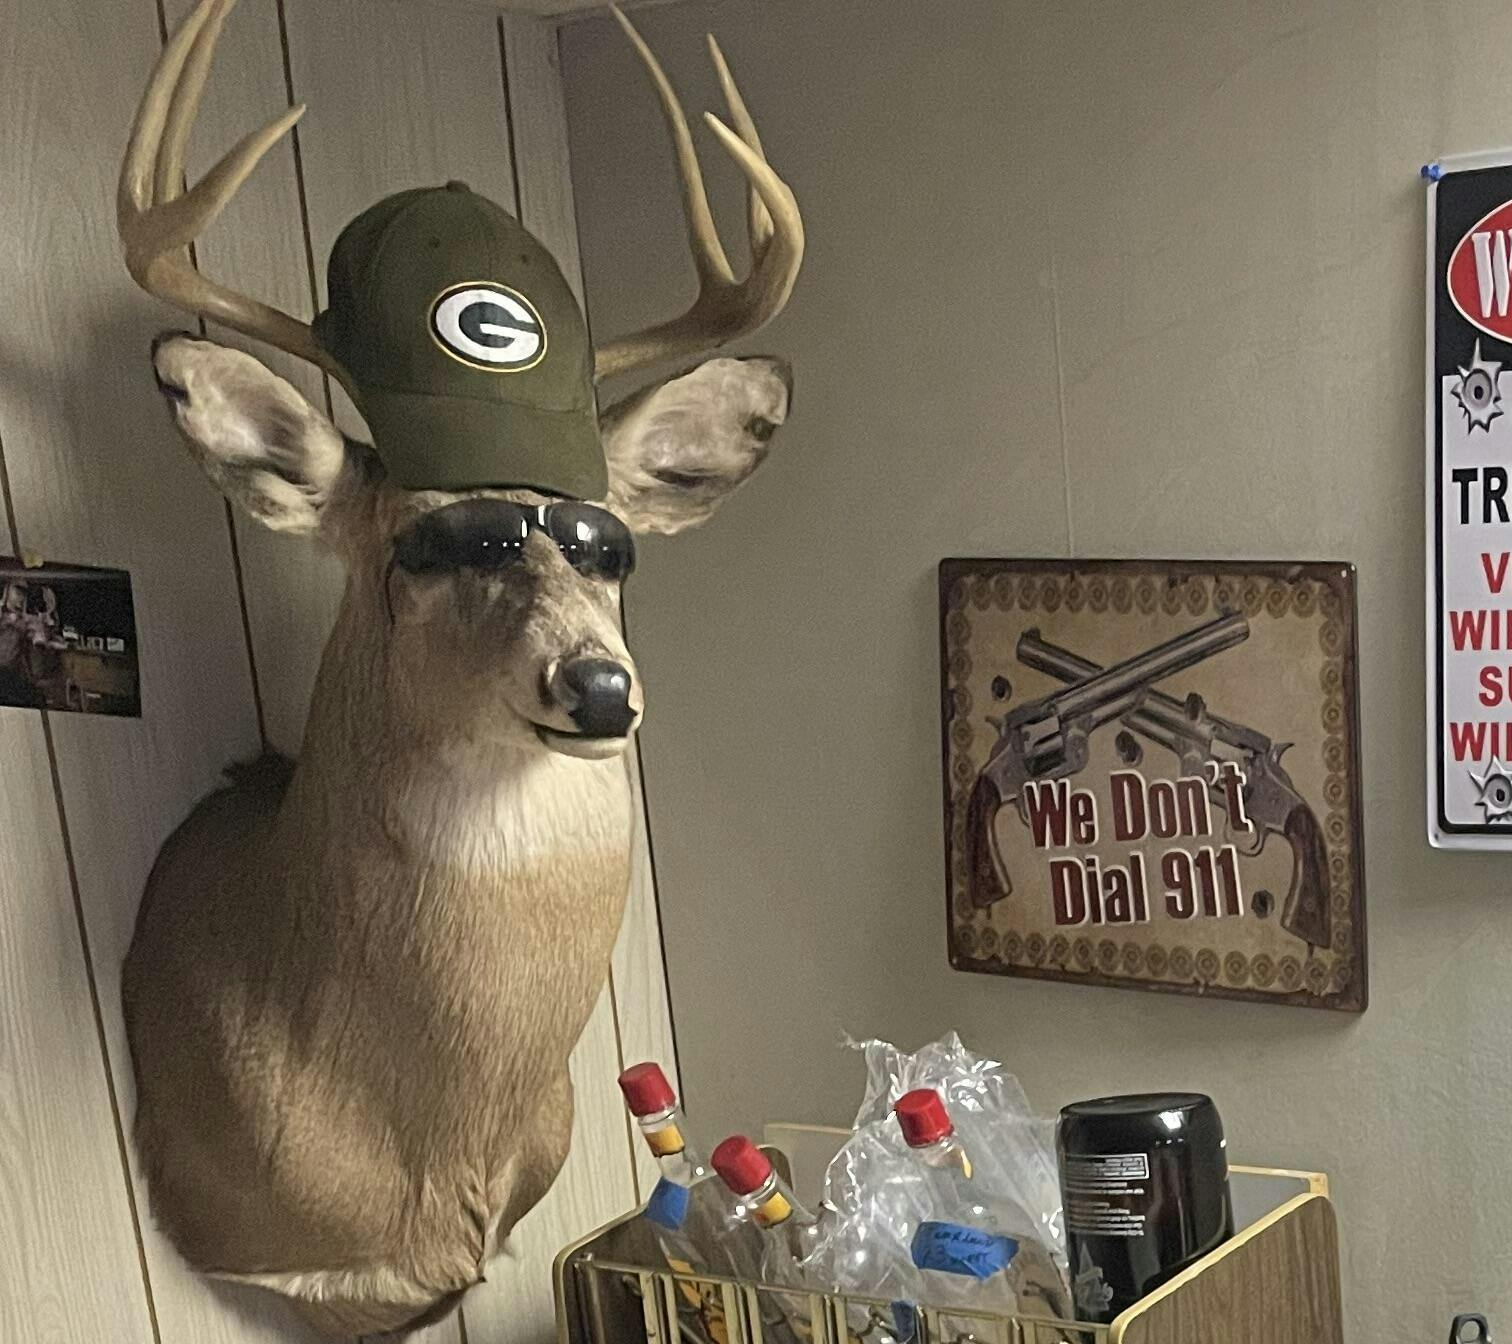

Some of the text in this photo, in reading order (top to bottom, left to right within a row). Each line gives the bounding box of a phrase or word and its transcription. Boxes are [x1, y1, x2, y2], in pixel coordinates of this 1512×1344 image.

[436, 289, 541, 363] G
[1023, 760, 1254, 850] We Don't
[1048, 844, 1245, 926] Dial 911
